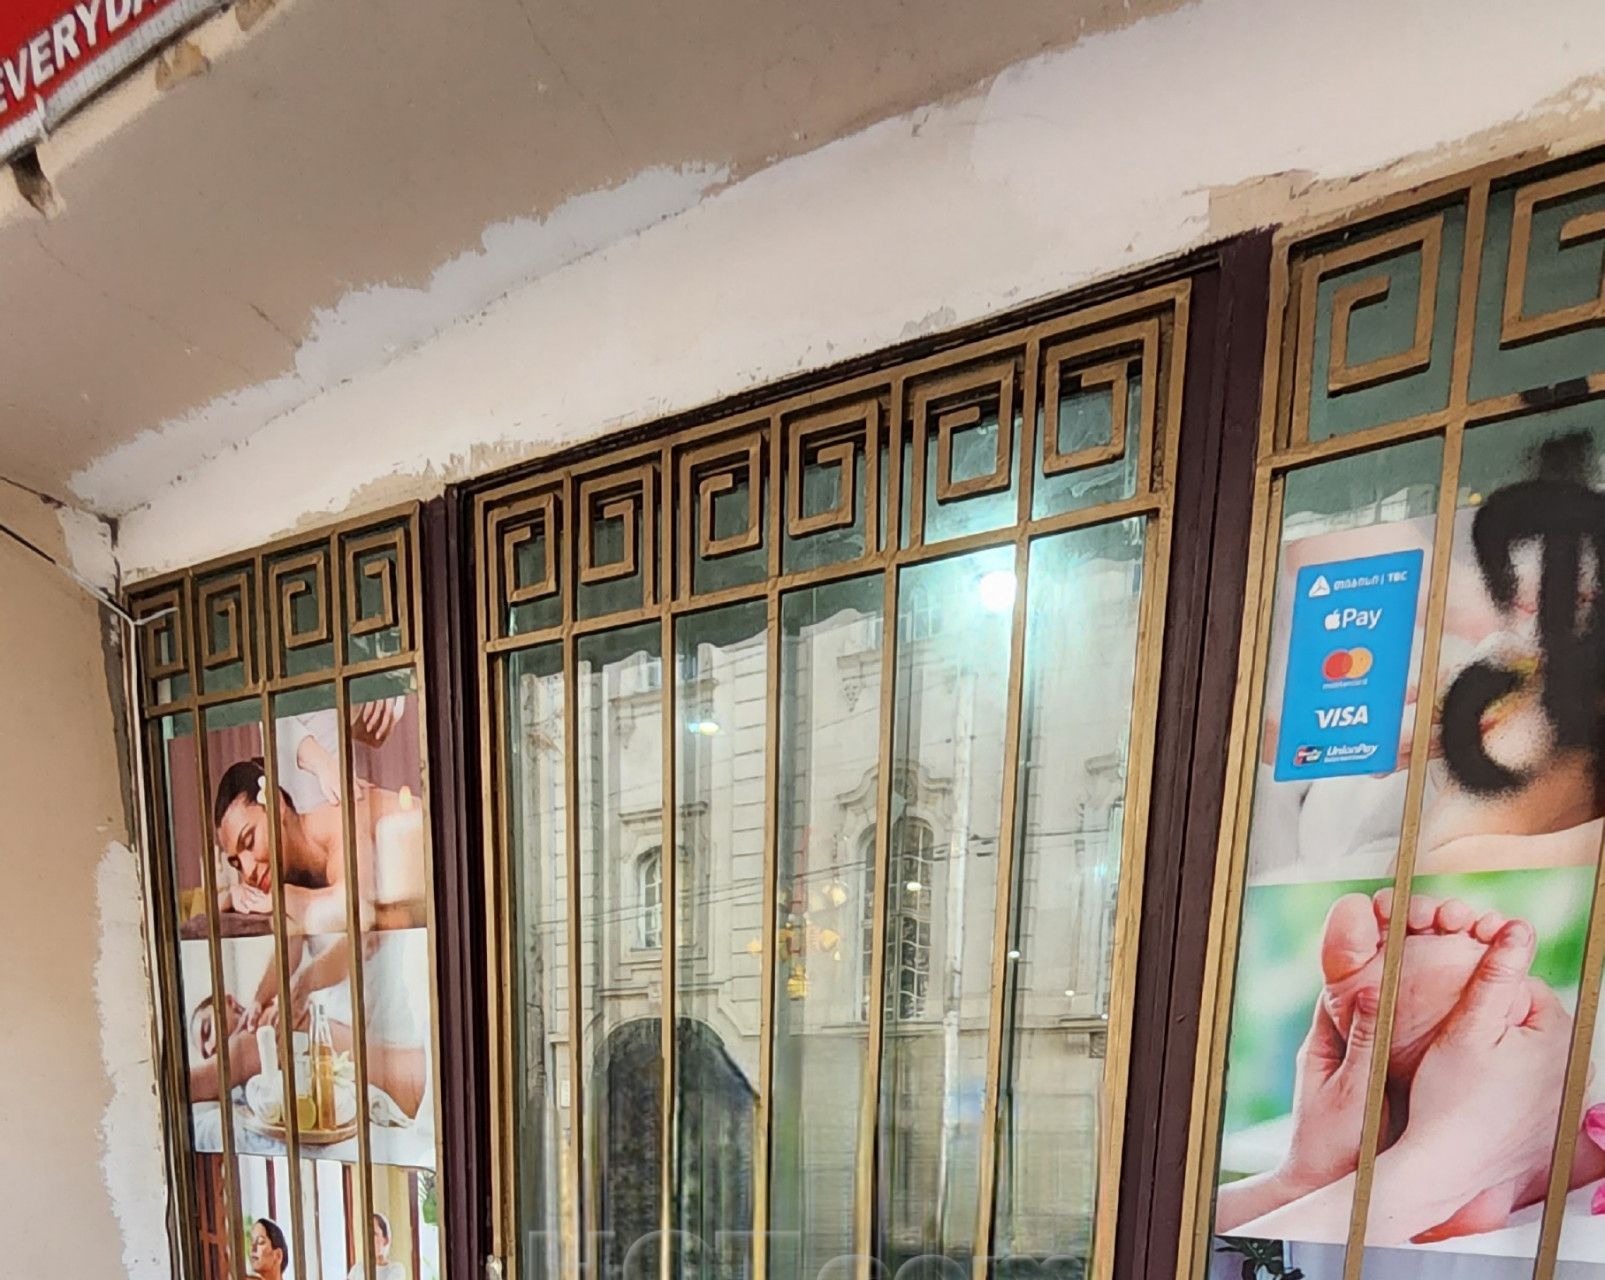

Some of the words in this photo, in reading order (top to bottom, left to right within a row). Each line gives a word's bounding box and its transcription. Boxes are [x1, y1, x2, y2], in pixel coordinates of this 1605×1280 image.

[0, 0, 157, 112] VERYD
[1341, 608, 1383, 629] Pay
[1315, 704, 1369, 729] VISA
